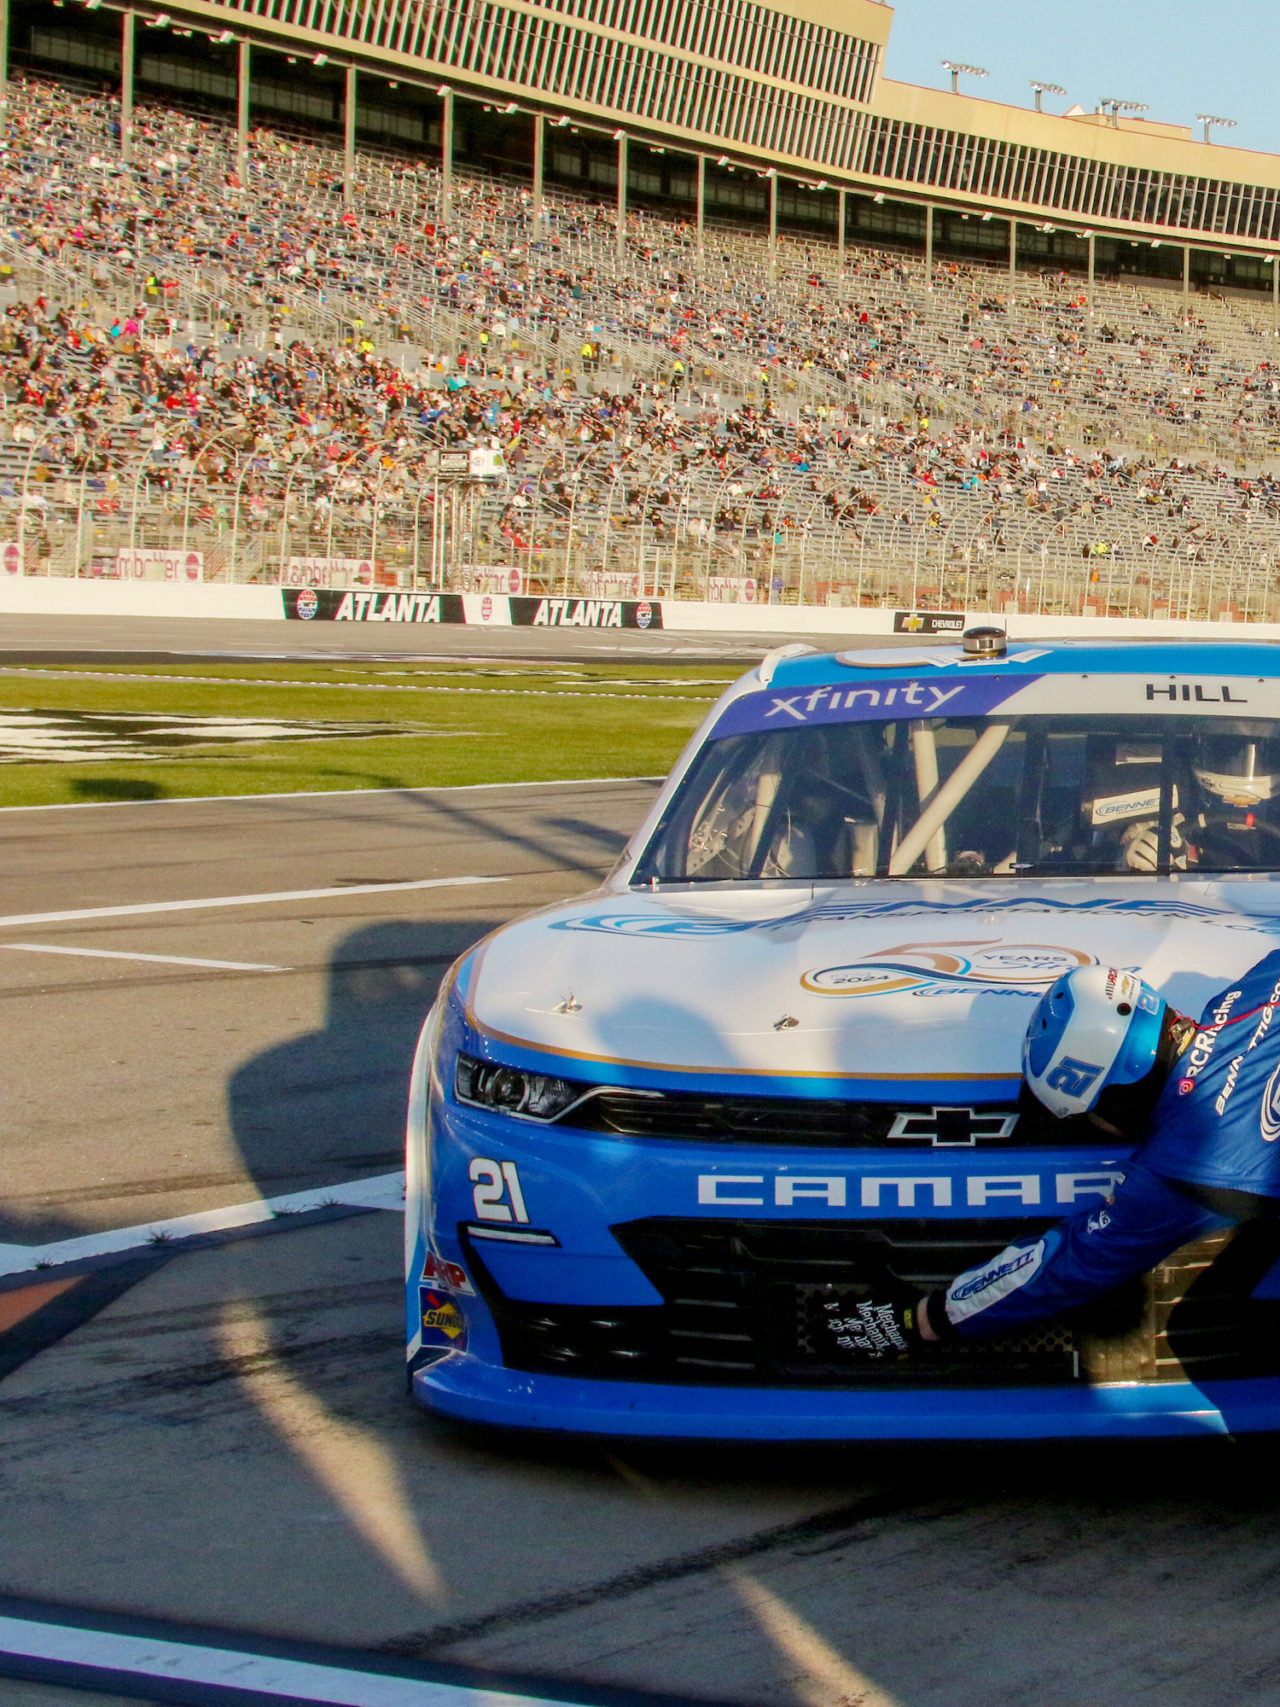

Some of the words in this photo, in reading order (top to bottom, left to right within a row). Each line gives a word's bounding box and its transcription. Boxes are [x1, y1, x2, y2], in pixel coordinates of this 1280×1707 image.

[334, 592, 442, 623] ATLANTA
[532, 599, 623, 628] ATLANTA
[931, 619, 964, 629] CHEVROLET
[763, 681, 967, 721] xfinity
[1145, 682, 1248, 704] HILL
[1105, 798, 1155, 814] BENNE
[983, 954, 1068, 962] YEARS
[833, 975, 890, 985] 2024
[937, 988, 1045, 998] BENNE
[1046, 1056, 1106, 1099] 21
[468, 1156, 530, 1224] 21
[698, 1171, 1118, 1207] CAMAR
[961, 1249, 1036, 1298] BENNETT
